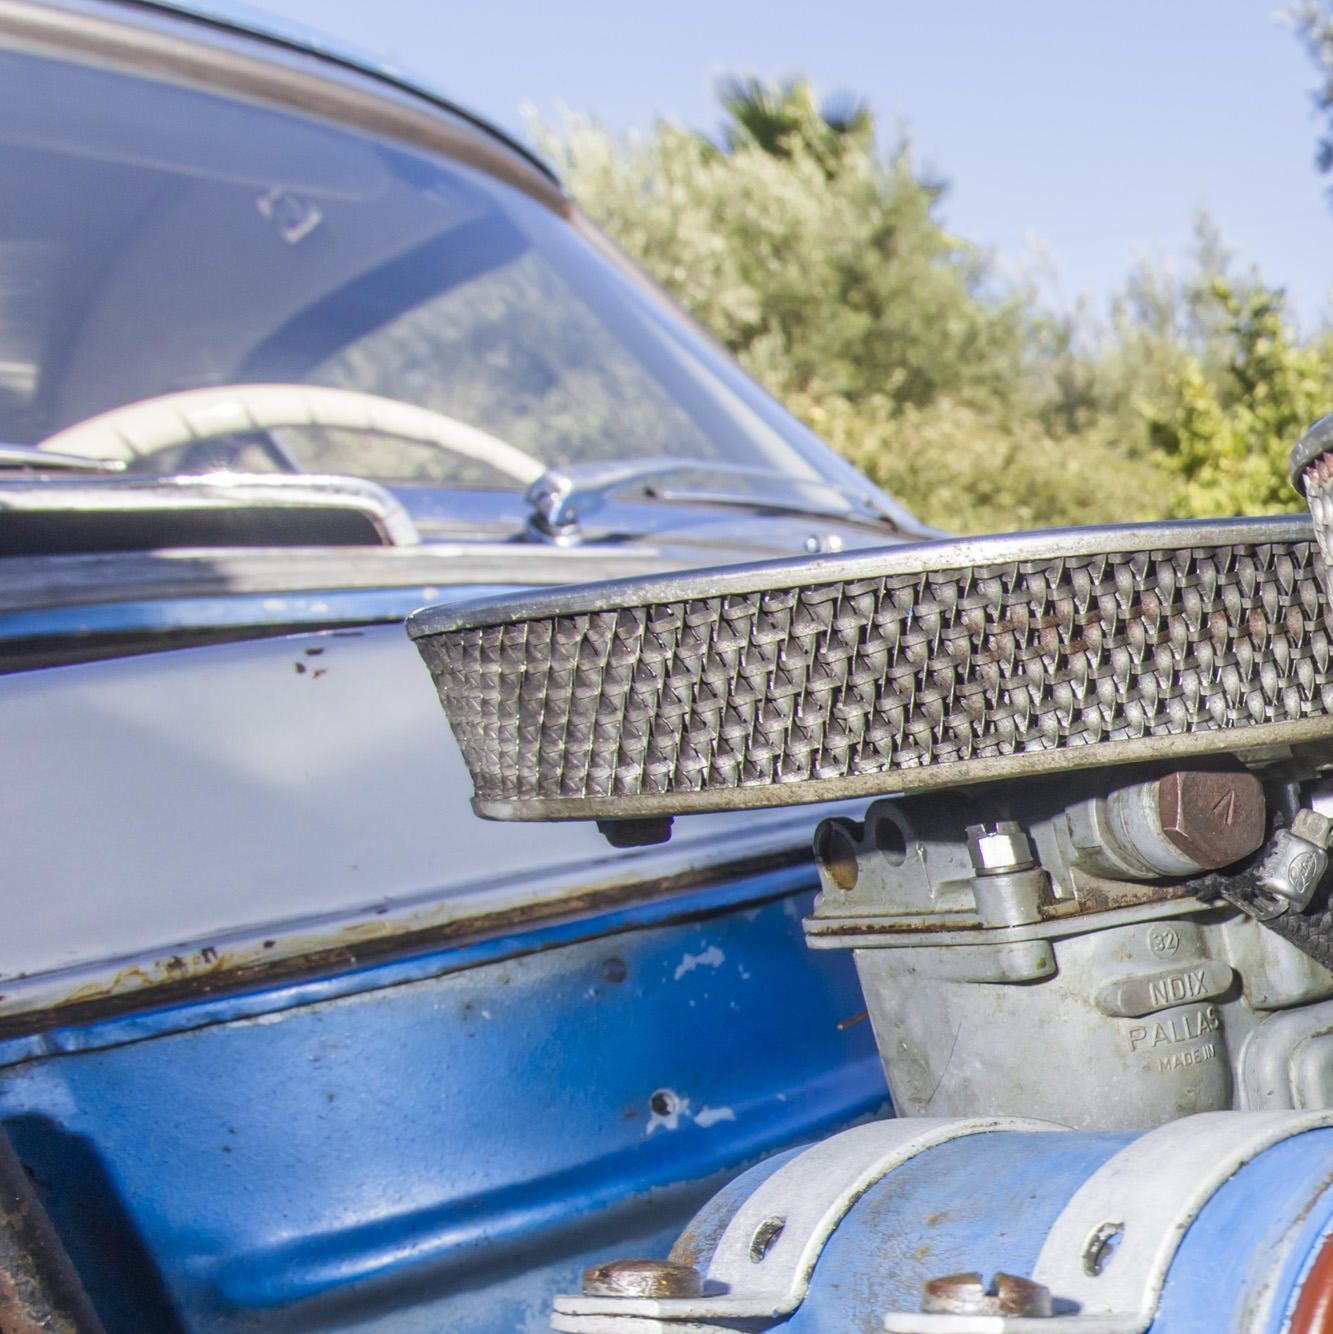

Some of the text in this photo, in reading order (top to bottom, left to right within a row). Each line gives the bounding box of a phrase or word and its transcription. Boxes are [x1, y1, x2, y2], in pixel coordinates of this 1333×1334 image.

[1151, 930, 1178, 952] 32
[1149, 967, 1209, 1008] NDIX
[1128, 1005, 1221, 1052] PALLAS
[1159, 1043, 1218, 1073] MADE IN
